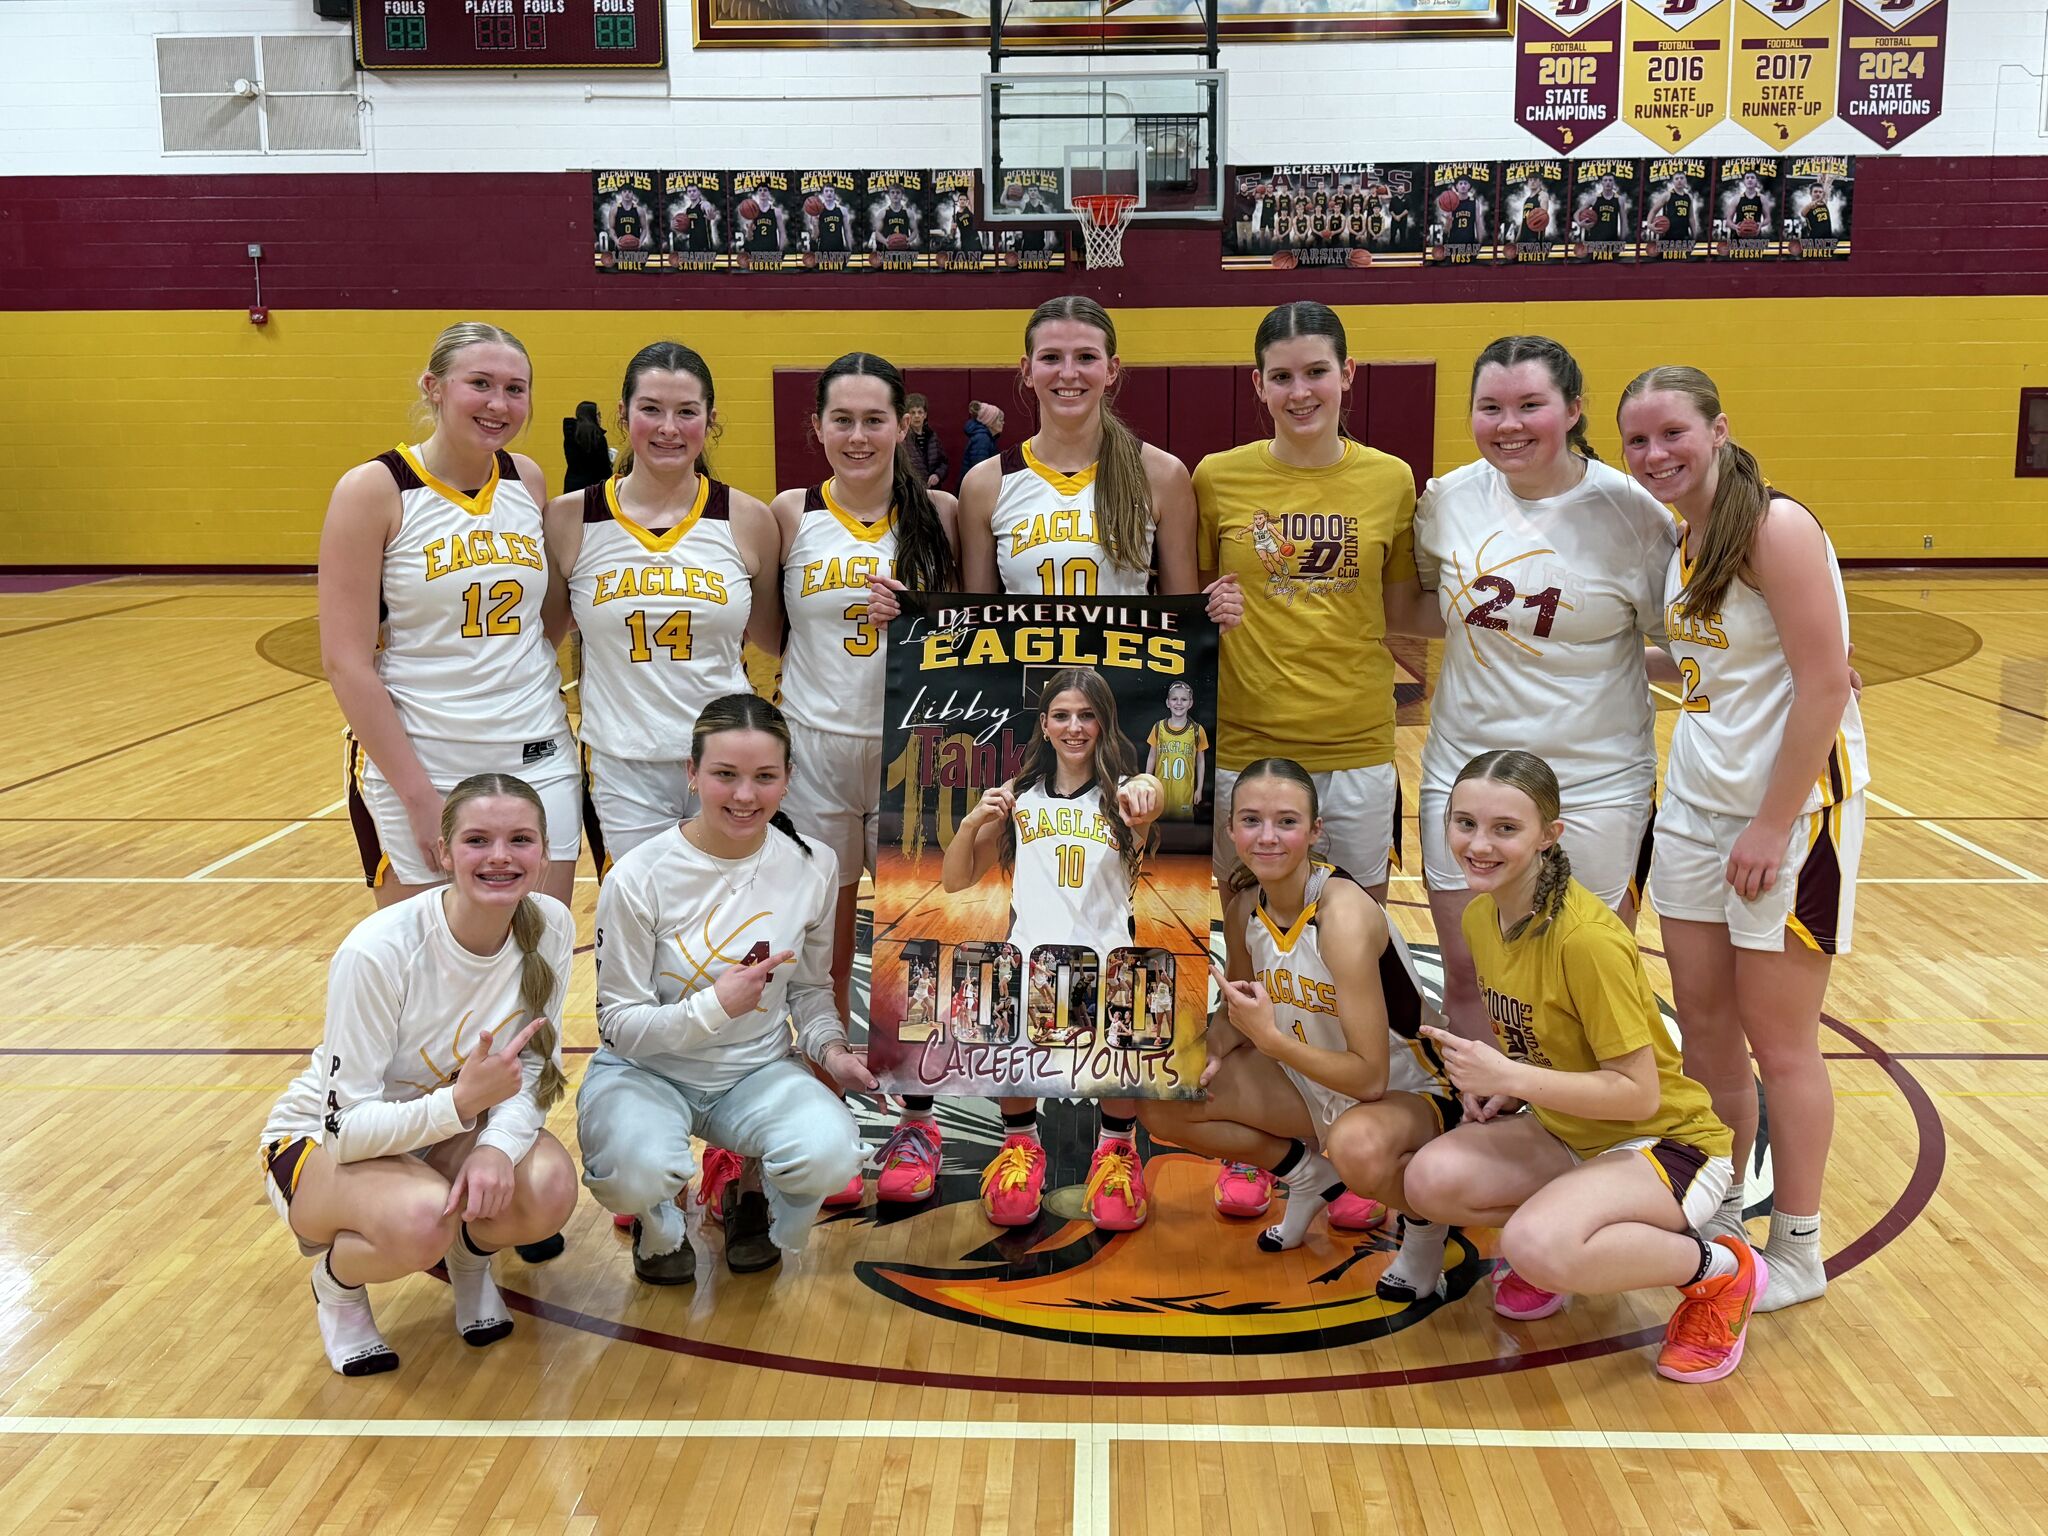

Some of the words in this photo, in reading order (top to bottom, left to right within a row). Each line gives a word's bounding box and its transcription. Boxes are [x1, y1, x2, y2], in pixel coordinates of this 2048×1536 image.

[384, 0, 426, 14] FOULS
[465, 0, 514, 13] PLAYER
[523, 0, 565, 13] FOULS
[593, 0, 635, 13] FOULS
[1550, 42, 1587, 52] FOOTBALL
[1657, 41, 1695, 51] FOOTBALL
[1766, 39, 1803, 49] FOOTBALL
[1875, 37, 1912, 46] FOOTBALL
[1538, 56, 1597, 85] 2012
[1647, 55, 1704, 82] 2016
[1755, 53, 1813, 81] 2017
[1859, 51, 1925, 80] 2024
[1545, 89, 1589, 105] STATE
[1653, 87, 1696, 102] STATE
[1761, 85, 1804, 101] STATE
[1869, 83, 1913, 99] STATE
[1525, 104, 1607, 121] CHAMPIONS
[1634, 103, 1714, 120] RUNNER-UP
[1742, 101, 1822, 118] RUNNER-UP
[1849, 99, 1931, 116] CHAMPIONS
[1273, 163, 1375, 176] DECKERVILLE
[1792, 162, 1848, 177] EAGLES
[935, 175, 975, 191] EAGL
[1601, 212, 1611, 222] 21
[1676, 207, 1687, 217] 30
[1744, 212, 1755, 221] 35
[1817, 213, 1828, 222] 23
[761, 225, 767, 235] 2
[829, 223, 836, 232] 3
[1458, 217, 1468, 228] 13
[801, 231, 811, 252] 3
[946, 250, 982, 262] IAN
[1291, 247, 1353, 260] VARSITY
[1451, 254, 1471, 263] VOSS
[1518, 252, 1547, 262] BENJEY
[1592, 251, 1614, 261] PARK
[1662, 249, 1688, 259] KUBIK
[1729, 249, 1764, 259] PERUSKI
[618, 261, 642, 271] NOBLE
[679, 261, 717, 271] SALOWITZ
[818, 261, 844, 271] KENNY
[882, 260, 912, 271] BOWLIN
[944, 260, 984, 271] FLANAGAN
[1017, 260, 1049, 270] SHANKS
[1011, 509, 1106, 559] EAGL
[1280, 513, 1344, 542] 1000
[1343, 516, 1358, 568] POINTS
[423, 530, 543, 581] EAGLES
[801, 556, 903, 598] EAGL
[1036, 557, 1099, 596] 10
[1337, 567, 1360, 578] CLUB
[593, 566, 729, 606] EAGLES
[461, 579, 524, 638] 12
[1465, 575, 1561, 638] 21
[938, 604, 1179, 632] DECKERVILLE
[1664, 602, 1729, 649] GLES
[625, 610, 694, 663] 14
[843, 603, 880, 657] 3
[899, 610, 976, 650] Lady
[920, 627, 1186, 675] EAGLES
[1679, 656, 1711, 713] 2
[897, 685, 1026, 746] Libby
[914, 726, 1028, 790] Tank
[1161, 757, 1185, 780] 10
[1055, 844, 1086, 888] 10
[898, 938, 1176, 1050] 1000
[1487, 987, 1521, 1030] 1000
[1291, 1019, 1308, 1045] 1
[918, 1029, 1064, 1085] CAREER
[1063, 1027, 1180, 1089] POINTS
